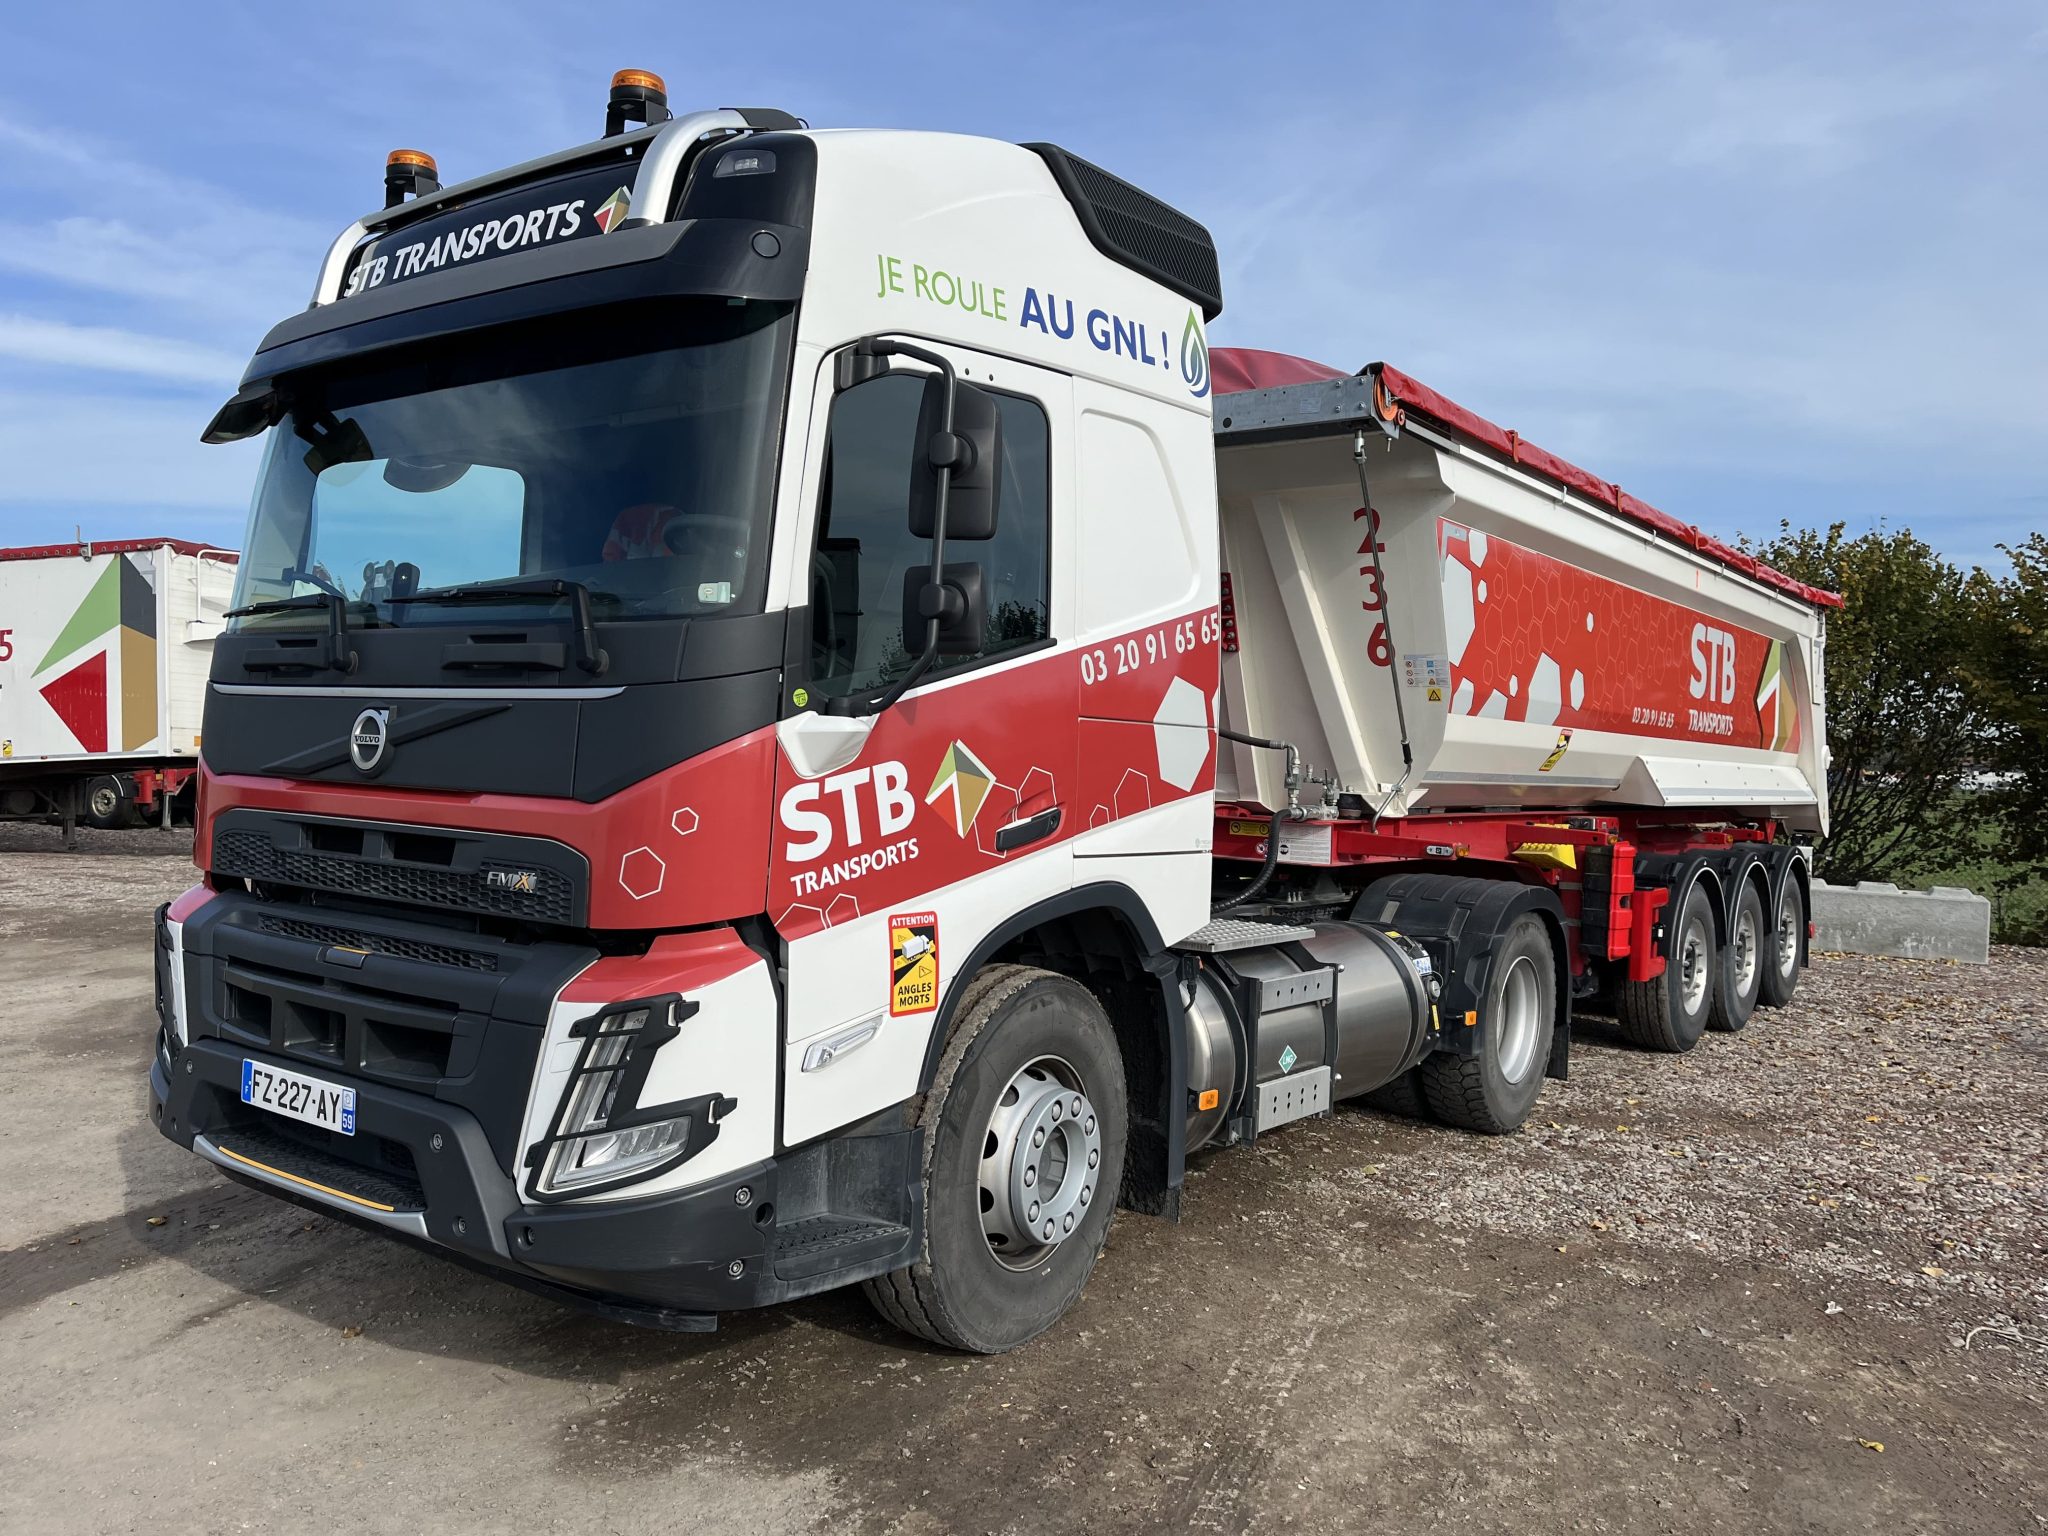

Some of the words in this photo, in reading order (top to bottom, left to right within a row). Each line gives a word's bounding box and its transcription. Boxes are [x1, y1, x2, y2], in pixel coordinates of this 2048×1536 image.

[345, 256, 389, 297] STB
[393, 199, 586, 280] TRANSPORTS
[878, 254, 904, 298] JE
[913, 264, 1007, 321] ROULE
[1020, 287, 1075, 340] AU
[1081, 650, 1107, 685] 03
[1114, 639, 1140, 675] 20
[1146, 629, 1167, 664] 91
[1175, 620, 1196, 653] 65
[1201, 612, 1219, 645] 65
[1689, 622, 1736, 705] STB
[354, 735, 380, 743] VOLVO
[1688, 709, 1734, 736] TRANSPORTS
[779, 760, 916, 862] STB
[790, 838, 919, 897] TRANSPORTS
[892, 914, 935, 927] ATTENTION
[898, 982, 932, 996] ANGLES
[899, 993, 930, 1007] MORTS
[342, 1113, 353, 1130] 59
